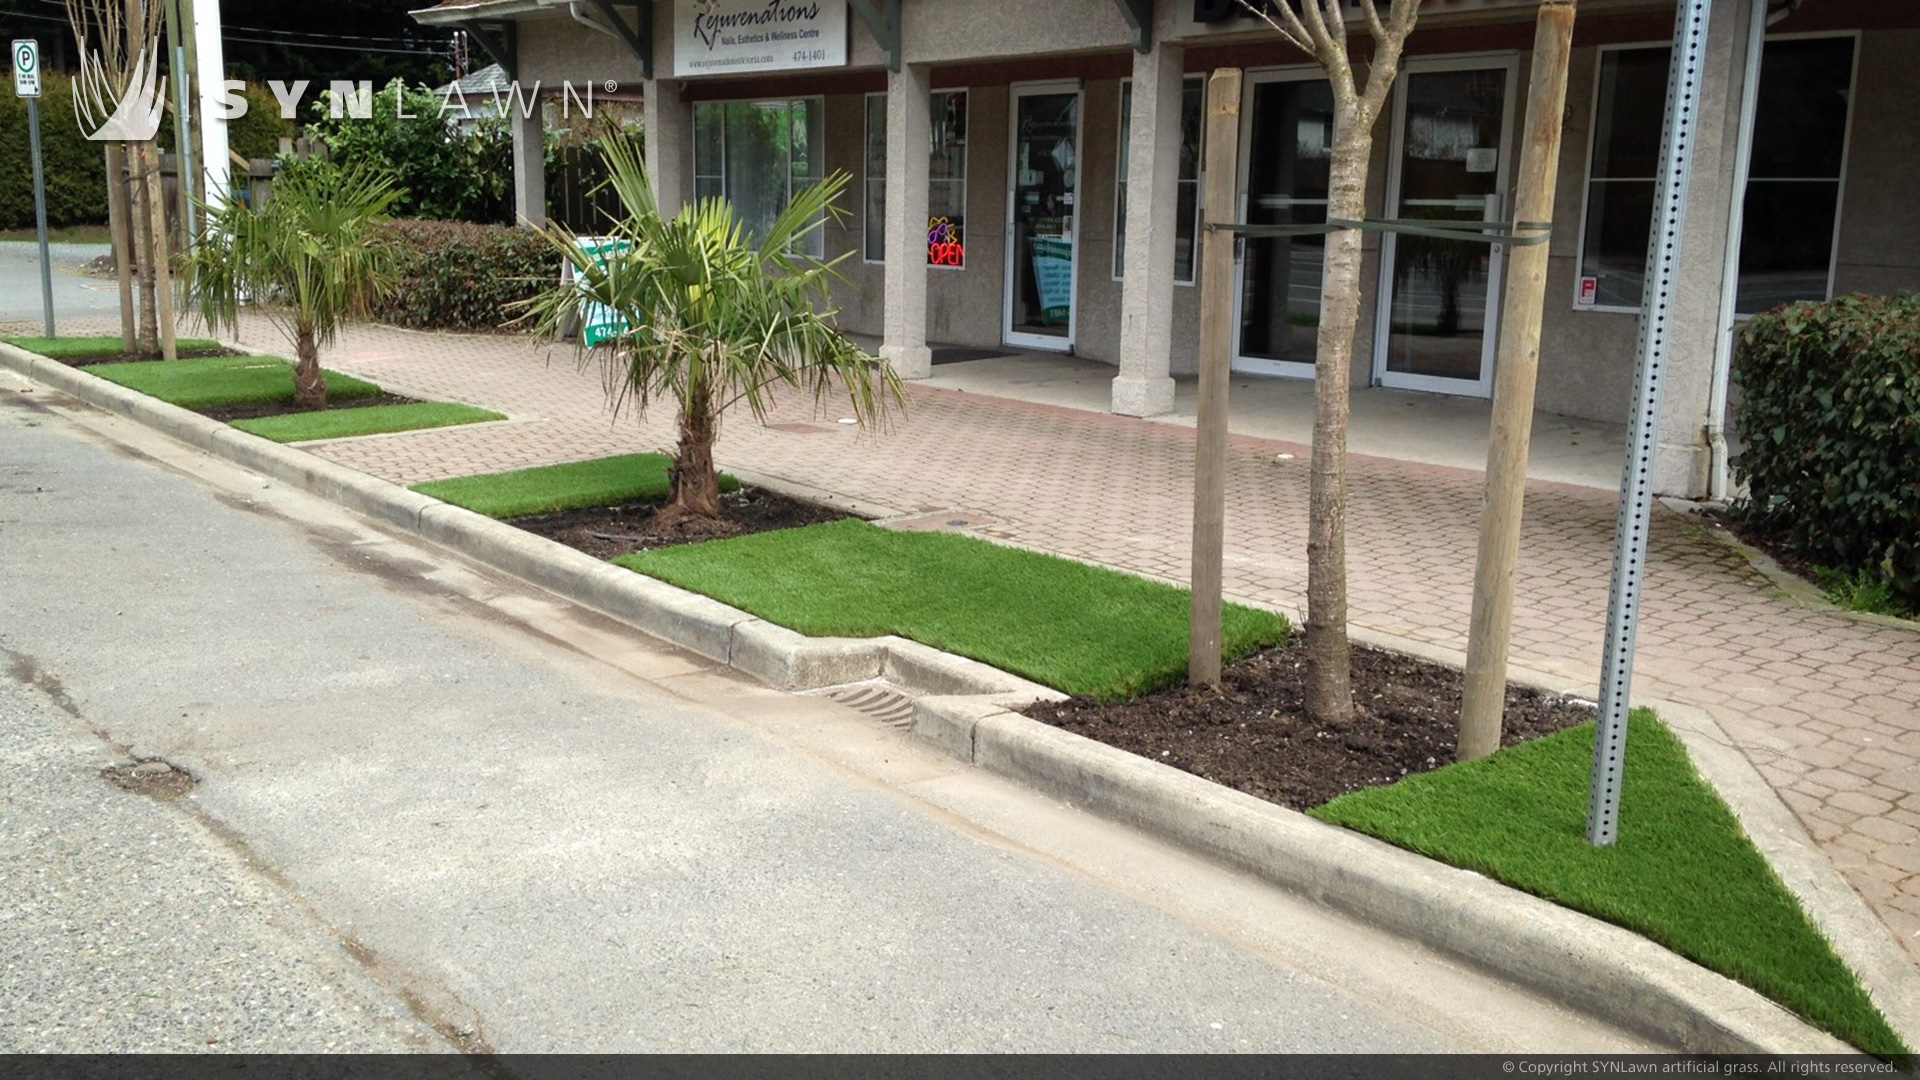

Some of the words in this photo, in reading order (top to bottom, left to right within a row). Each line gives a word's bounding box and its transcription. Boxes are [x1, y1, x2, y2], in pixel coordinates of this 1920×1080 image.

[770, 31, 798, 41] Wellness
[799, 28, 820, 39] Centre
[793, 49, 826, 62] 474-1401
[931, 243, 964, 265] OPEN
